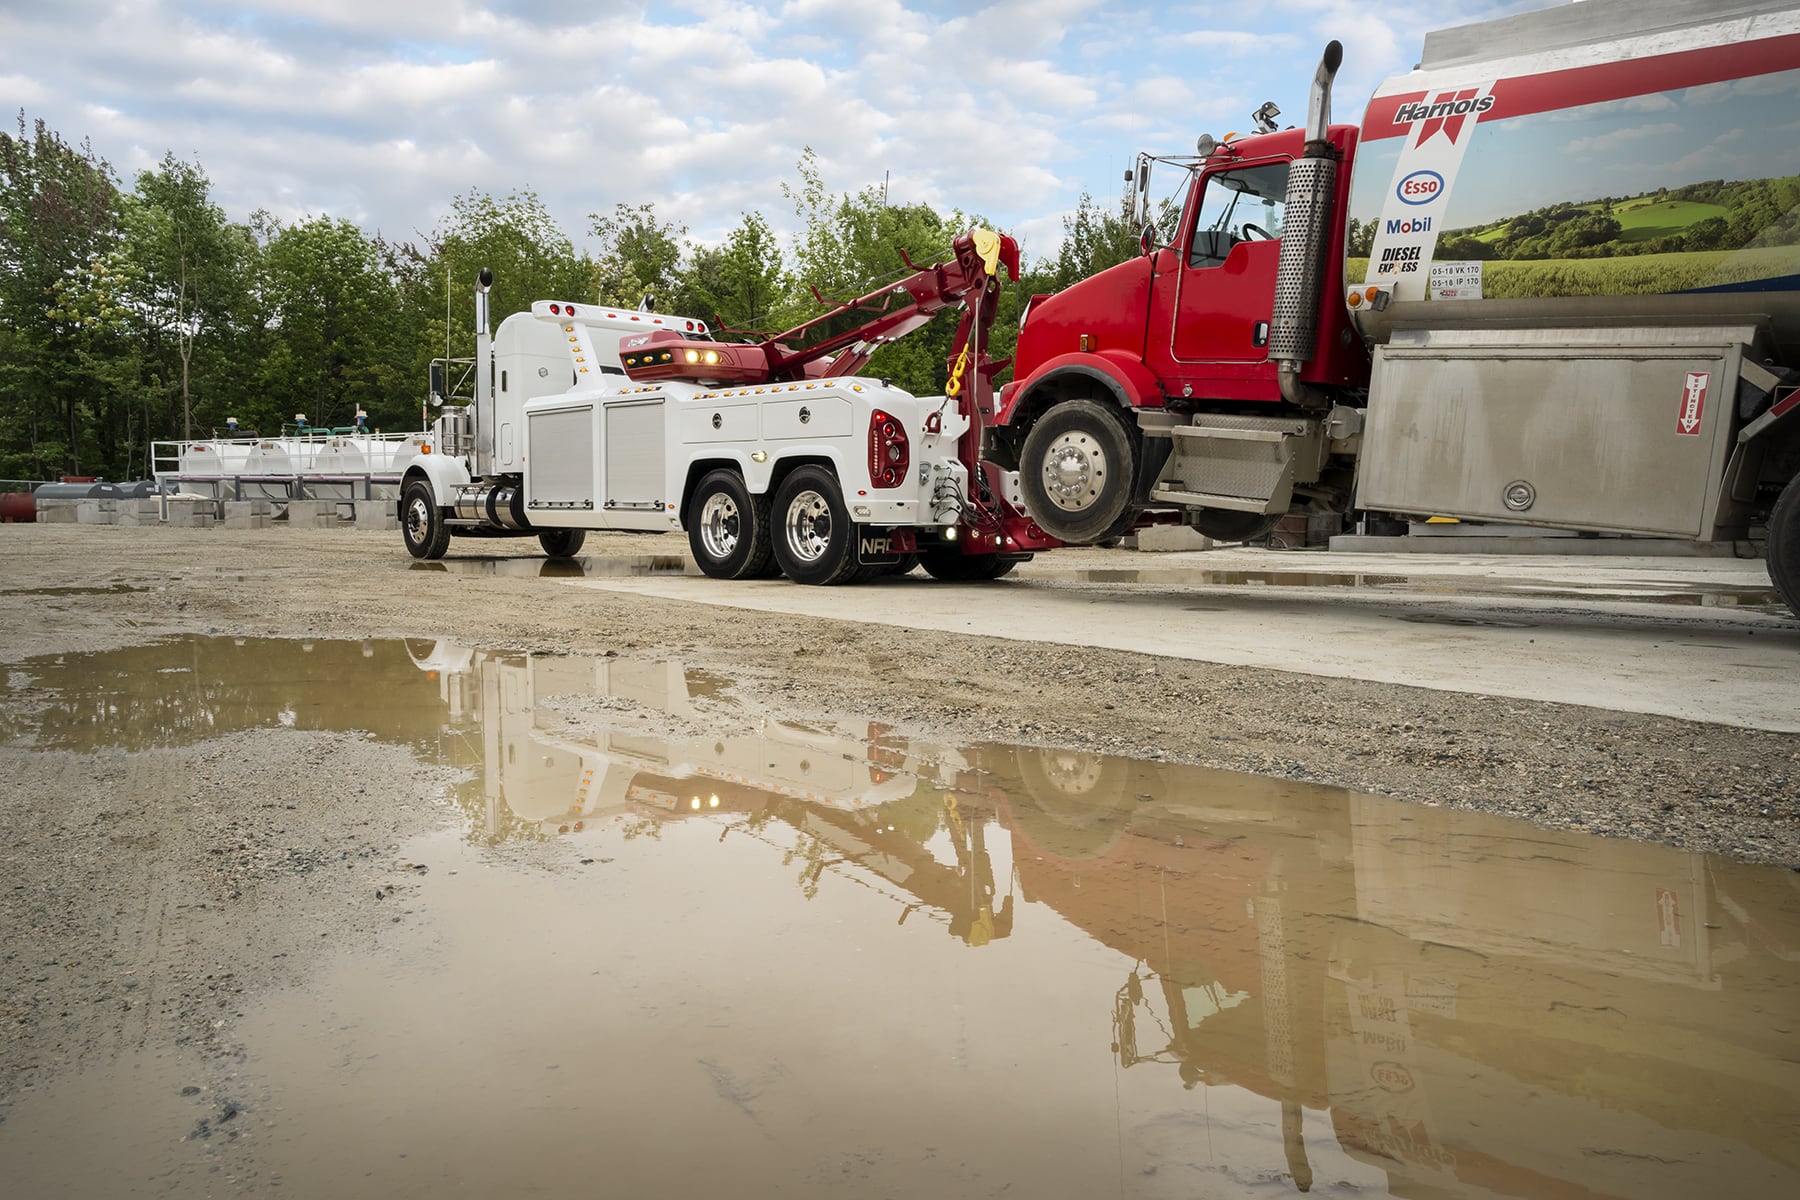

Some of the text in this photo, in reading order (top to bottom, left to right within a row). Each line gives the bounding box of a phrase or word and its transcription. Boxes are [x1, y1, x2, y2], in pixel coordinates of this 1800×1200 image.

[1394, 96, 1494, 123] Harnois
[1404, 180, 1438, 195] Esso
[1386, 216, 1432, 234] Mobil
[1381, 246, 1422, 261] DIESEL
[1378, 261, 1418, 274] EXPESS
[1455, 266, 1465, 274] VK
[1467, 265, 1480, 274] 170
[1685, 378, 1700, 430] EXTINCTEUR
